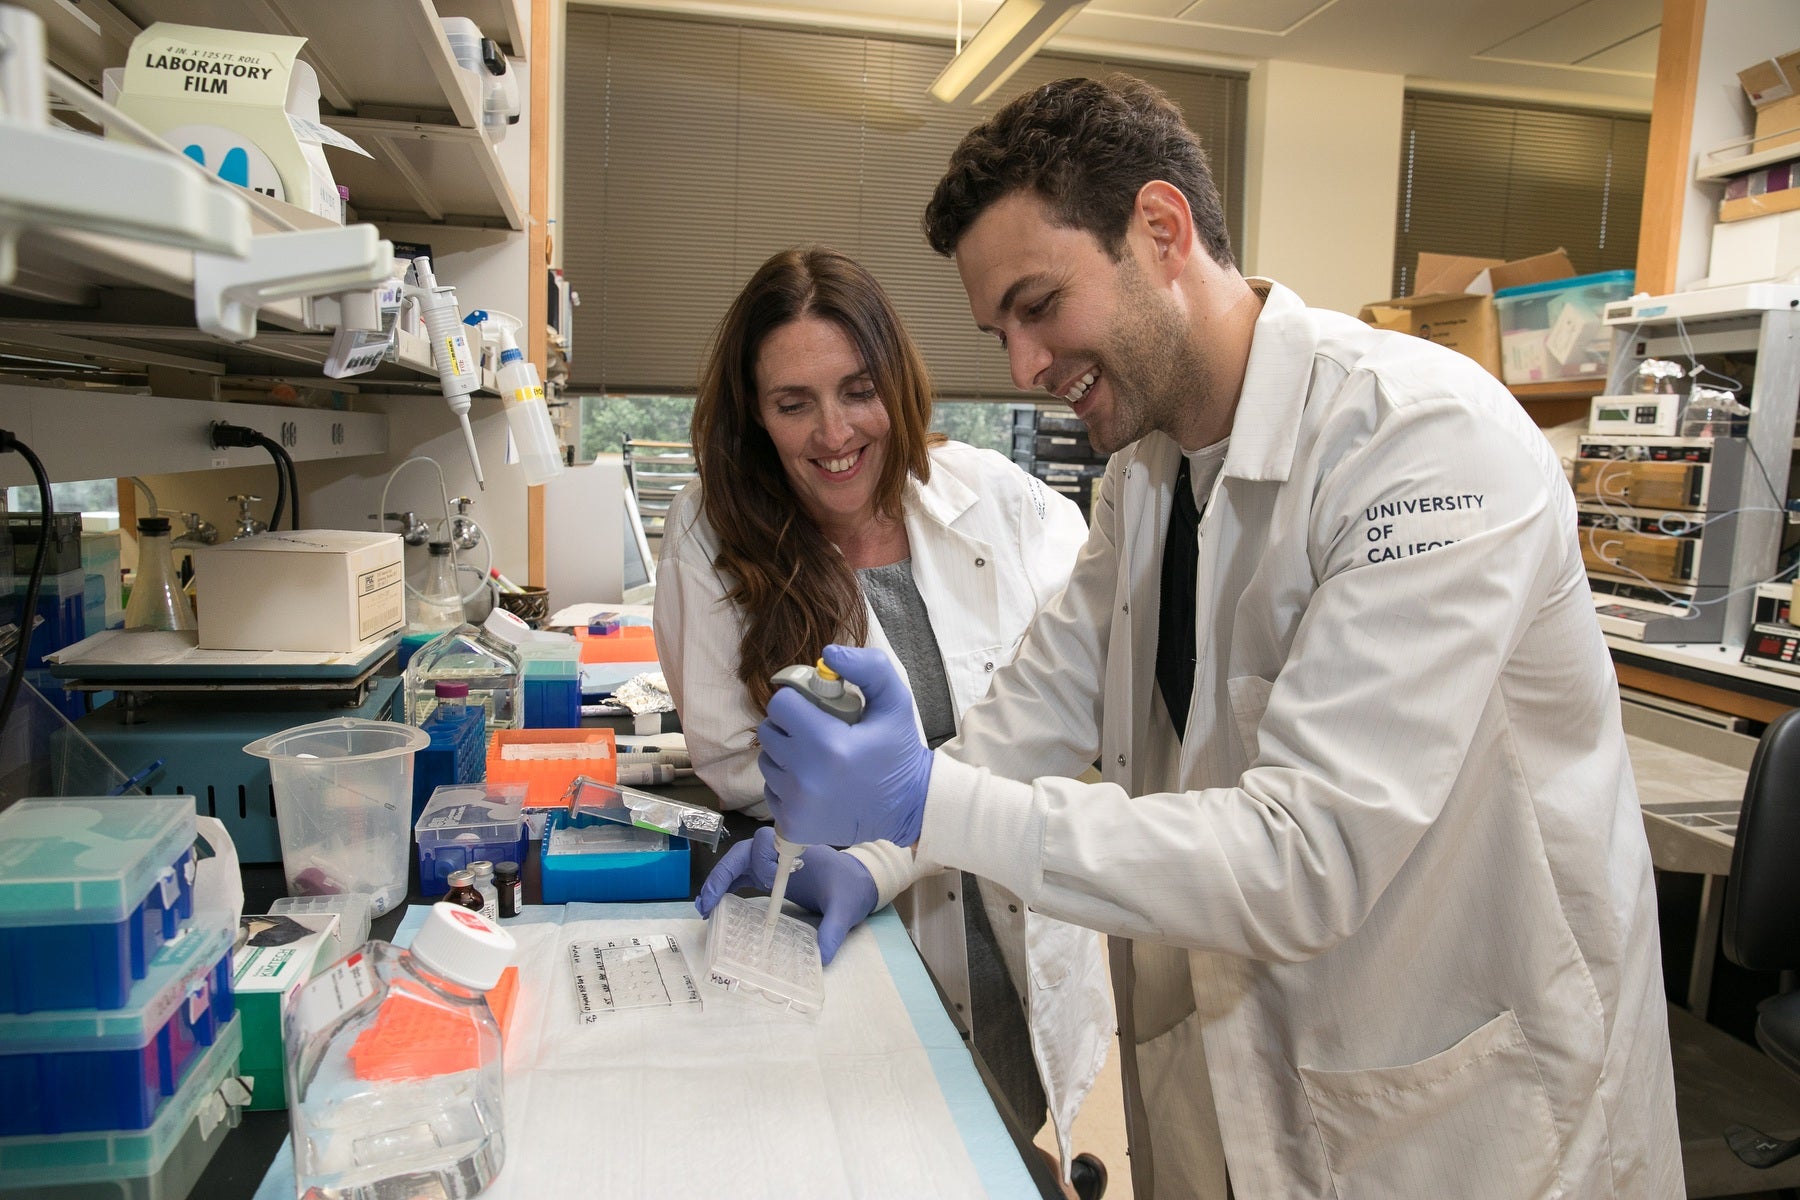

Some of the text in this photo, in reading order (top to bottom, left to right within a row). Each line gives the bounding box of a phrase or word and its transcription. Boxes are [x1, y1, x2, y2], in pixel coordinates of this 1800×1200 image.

[145, 53, 272, 80] LABORATORY
[202, 51, 219, 60] 125
[237, 55, 261, 65] ROLL
[184, 75, 228, 94] FILM
[1366, 494, 1484, 522] UNIVERSITY
[1367, 524, 1393, 542] OF
[259, 948, 291, 977] KIMTECH
